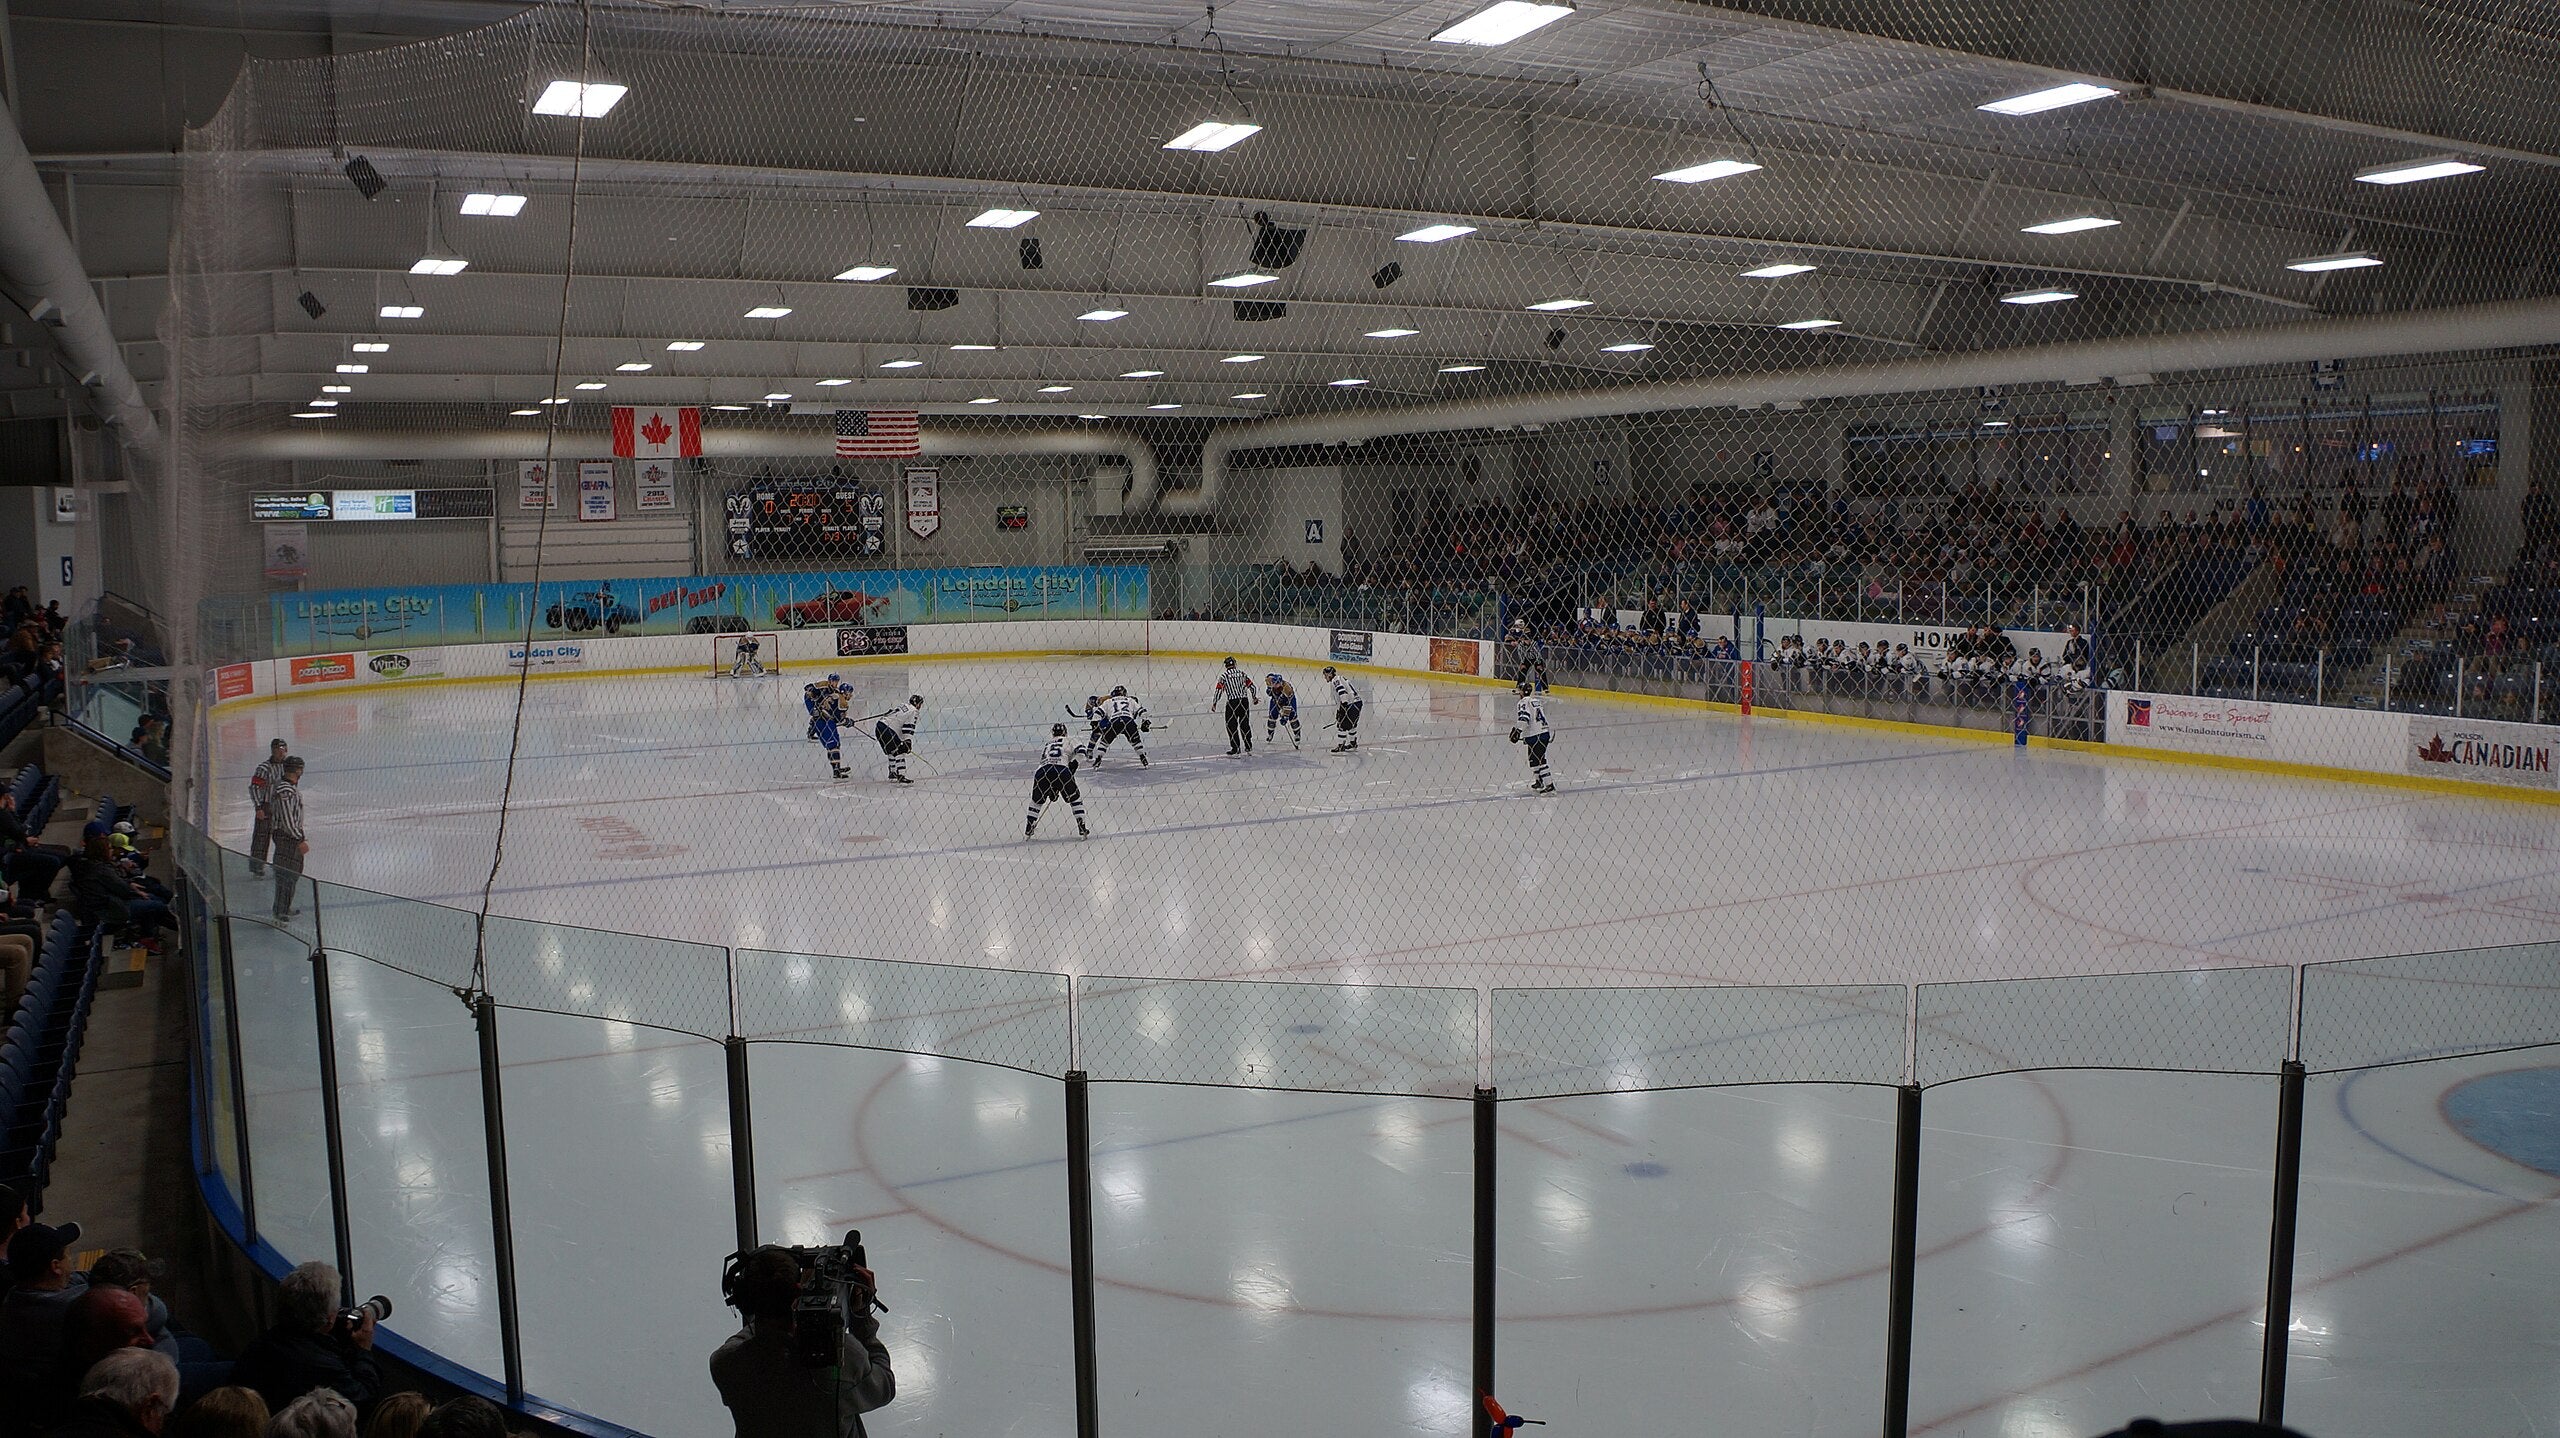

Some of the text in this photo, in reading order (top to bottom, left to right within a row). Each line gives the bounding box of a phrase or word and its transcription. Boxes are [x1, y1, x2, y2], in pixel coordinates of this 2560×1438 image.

[756, 493, 775, 501] HOME
[836, 491, 855, 500] GUEST
[765, 501, 774, 514] 0
[1308, 523, 1321, 540] A
[64, 560, 73, 582] S
[942, 574, 1080, 593] London City
[298, 595, 433, 618] London City
[1913, 631, 1960, 649] HOM
[557, 646, 581, 657] City
[372, 656, 408, 671] Winks
[1113, 701, 1130, 714] 12
[2156, 703, 2270, 727] Discover our Spirit!
[2158, 724, 2267, 741] www.londontourism.ca
[2454, 732, 2484, 741] MOLSON
[2452, 741, 2550, 772] CANADIAN
